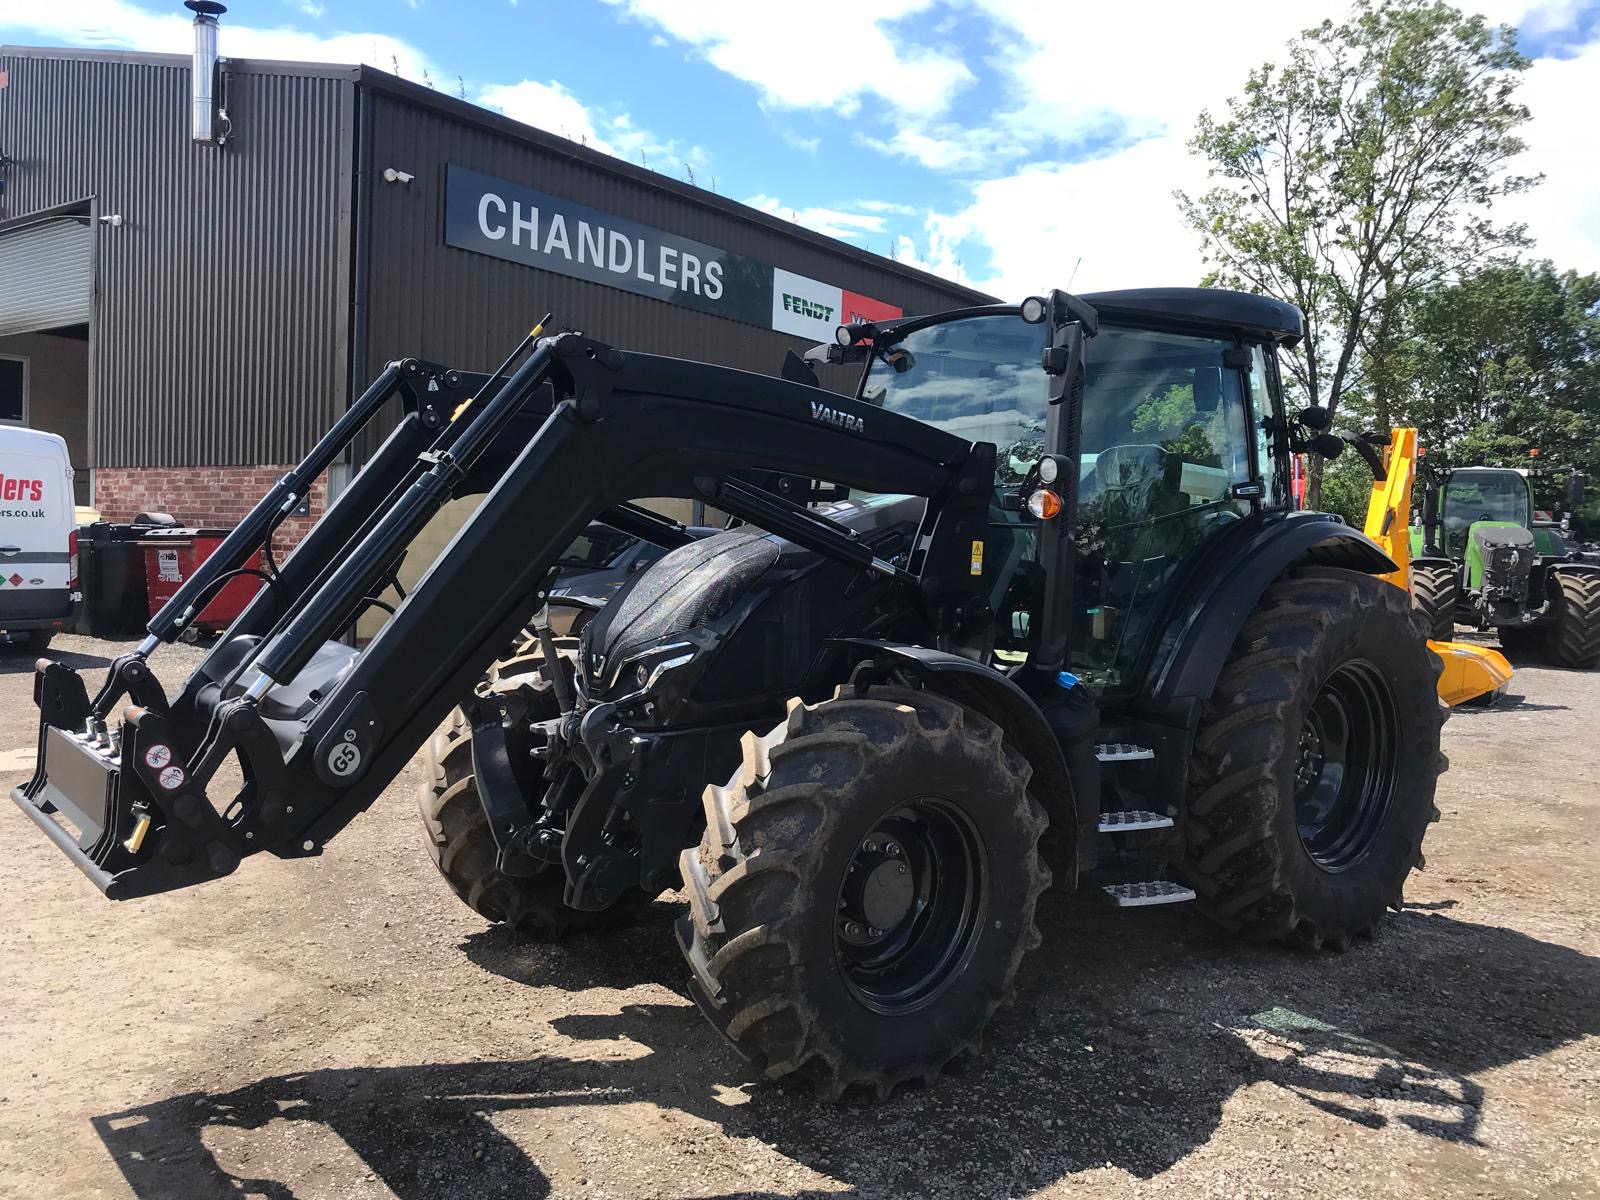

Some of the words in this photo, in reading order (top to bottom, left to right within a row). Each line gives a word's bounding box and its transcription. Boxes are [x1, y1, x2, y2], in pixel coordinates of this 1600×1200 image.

[478, 192, 725, 300] CHANDLERS
[782, 293, 834, 322] FENDT
[810, 401, 864, 433] VALTRA
[0, 508, 45, 518] rs.co.uk
[333, 744, 356, 773] G5
